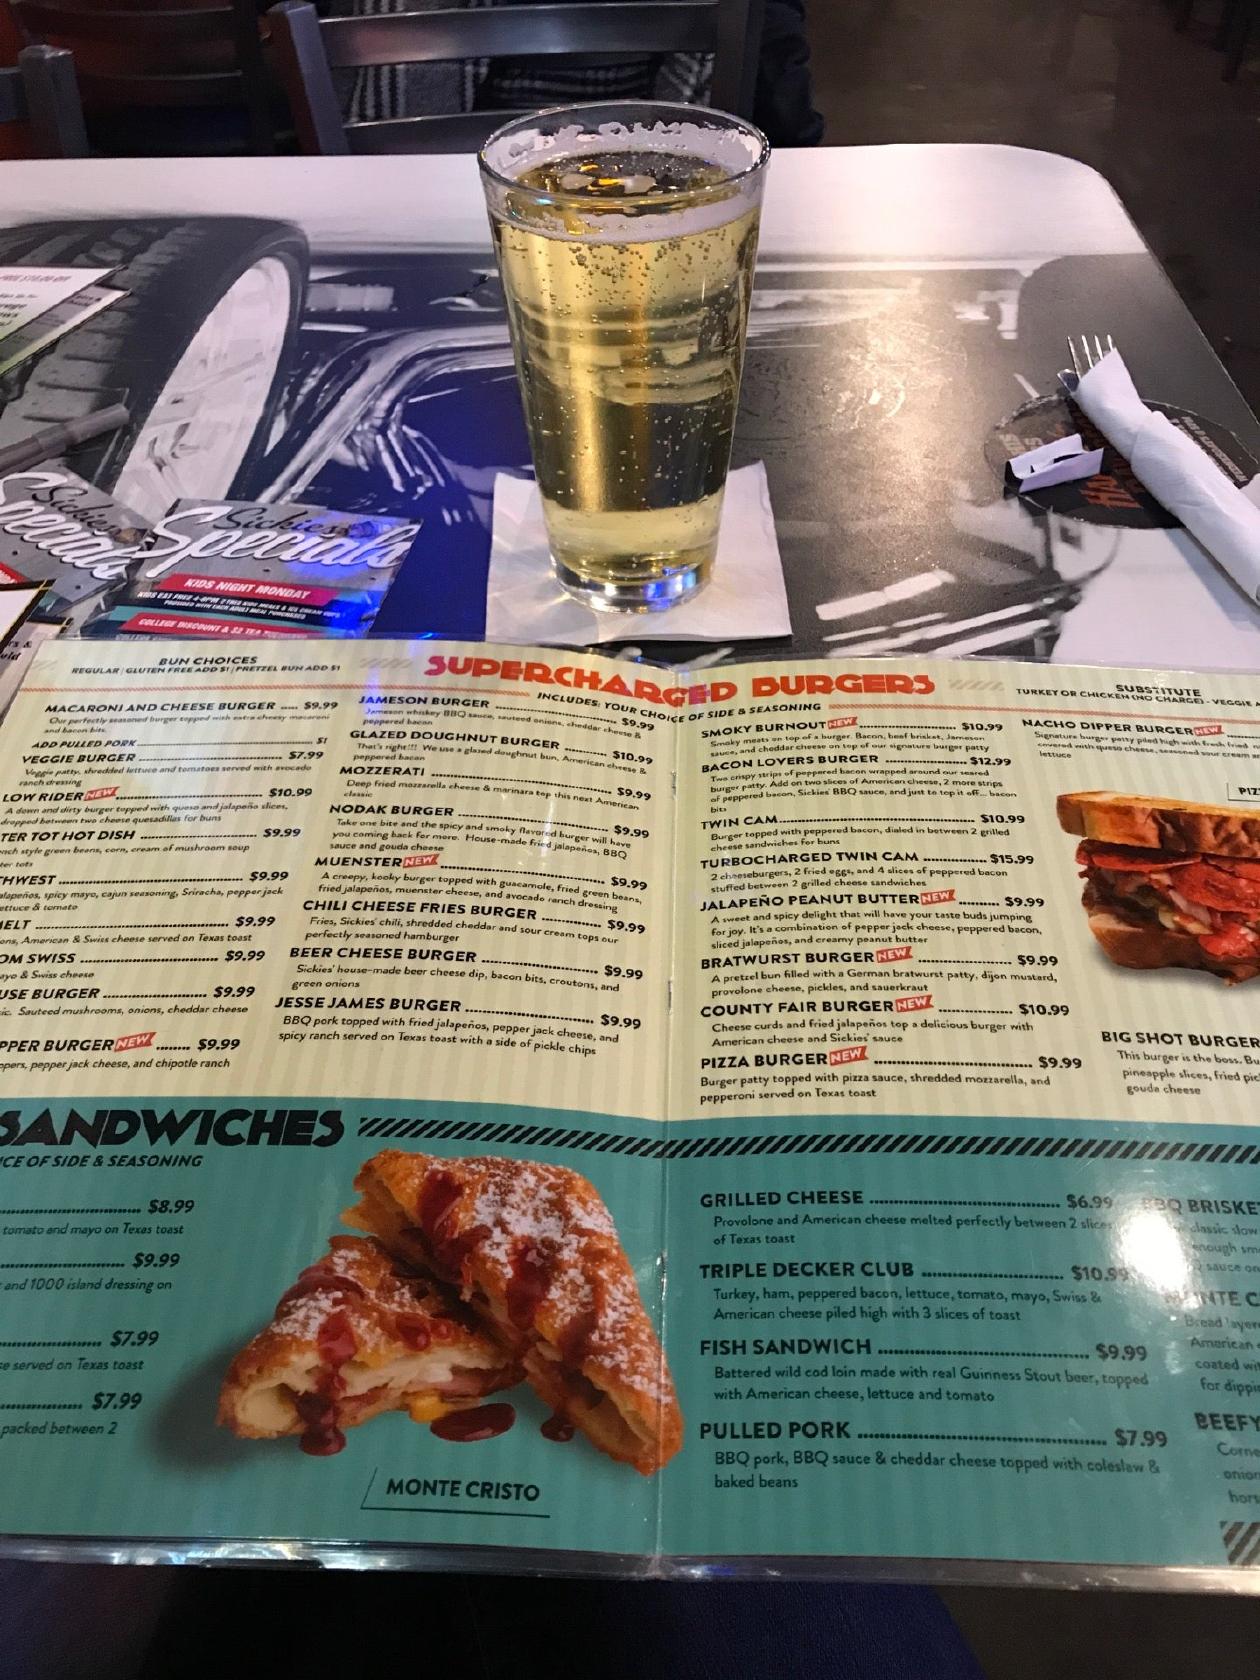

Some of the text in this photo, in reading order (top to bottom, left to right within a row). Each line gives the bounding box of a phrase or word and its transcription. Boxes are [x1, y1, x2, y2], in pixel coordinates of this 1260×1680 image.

[214, 507, 344, 533] Sickies
[133, 505, 422, 577] Specials
[184, 577, 312, 599] KIDS NIGHT MONDAY
[159, 656, 257, 666] BUN CHOICES
[424, 656, 935, 707] SUPERCHARGED BURGERS
[1116, 684, 1201, 697] SUBSTITUTE
[45, 701, 338, 713] MACARONI AND CHEESE BURGER $9.99
[359, 696, 654, 731] JAMESON BURGER $9.99
[537, 692, 600, 707] INCLUDES:
[605, 702, 637, 714] YOUR
[640, 710, 685, 723] CHOICE
[688, 712, 704, 721] OF
[707, 709, 734, 718] SIDE
[749, 703, 821, 714] SEASONING
[701, 716, 1003, 738] SMOKY BURNOUT NEW $10.99
[1022, 719, 1221, 736] NACHO DIPPER BURGER NEW
[32, 741, 58, 749] ADD
[59, 740, 102, 748] PULLED
[350, 730, 653, 765] GLAZED DOUGHNUT BURGER $10.99
[23, 751, 324, 764] VEGGIE BURGER $7.99
[702, 755, 1011, 773] BACON LOVERS BURGER $12.99
[339, 766, 651, 801] MOZZERATI $9.99
[3, 787, 312, 802] LOW RIDER NEW $10.99
[329, 805, 649, 838] NODAK BURGER $9.99
[701, 814, 1025, 830] TWIN CAM $10.99
[31, 832, 60, 841] TOT
[61, 831, 95, 841] HOT
[97, 830, 136, 840] DISH
[263, 828, 301, 838] $9.99
[700, 852, 1034, 869] TURBOCHARGED TWIN CAM $15.99
[314, 854, 647, 891] MUENSTER NEW $9.99
[700, 889, 1044, 912] JALAPEÑO PEANUT BUTTER NEW $9.99
[303, 900, 645, 934] CHILI CHEESE FRIES BURGER $9.99
[305, 929, 459, 944] perfectly seasoned hamburger
[290, 947, 643, 980] BEER CHEESE BURGER $9.99
[701, 946, 1058, 969] BRATWURST BURGER NEW $9.99
[275, 997, 641, 1030] JESSE JAMES BURGER $9.99
[700, 995, 1069, 1017] COUNTY FAIR BURGER NEW $10.99
[1101, 1031, 1260, 1048] BIG SHOT BURGER
[701, 1046, 1082, 1069] PIZZA BURGER NEW $9.99
[700, 1094, 755, 1105] pepperoni
[759, 1088, 795, 1099] served
[815, 1088, 845, 1097] Texas
[848, 1089, 876, 1097] toast
[1126, 1083, 1201, 1095] gouda cheese
[148, 1199, 194, 1214] $8.99
[700, 1191, 1113, 1210] GRILLED CHEESE $6.99
[3, 1226, 44, 1235] tomato
[46, 1223, 69, 1235] and
[70, 1227, 102, 1238] mayo
[123, 1222, 152, 1234] Texas
[156, 1225, 184, 1234] toast
[132, 1252, 180, 1269] $9.99
[699, 1263, 767, 1279] TRIPLE
[773, 1262, 854, 1277] DECKER
[860, 1262, 914, 1277] CLUB
[110, 1330, 159, 1347] $7.99
[701, 1339, 1147, 1361] FISH SANDWICH $9.99
[92, 1392, 142, 1410] $7.99
[714, 1386, 995, 1402] with American cheese, lettuce and tomato
[700, 1421, 1167, 1448] PULLED PORK $7.99
[386, 1479, 540, 1501] MONTE CRISTO
[715, 1474, 798, 1488] baked beans
